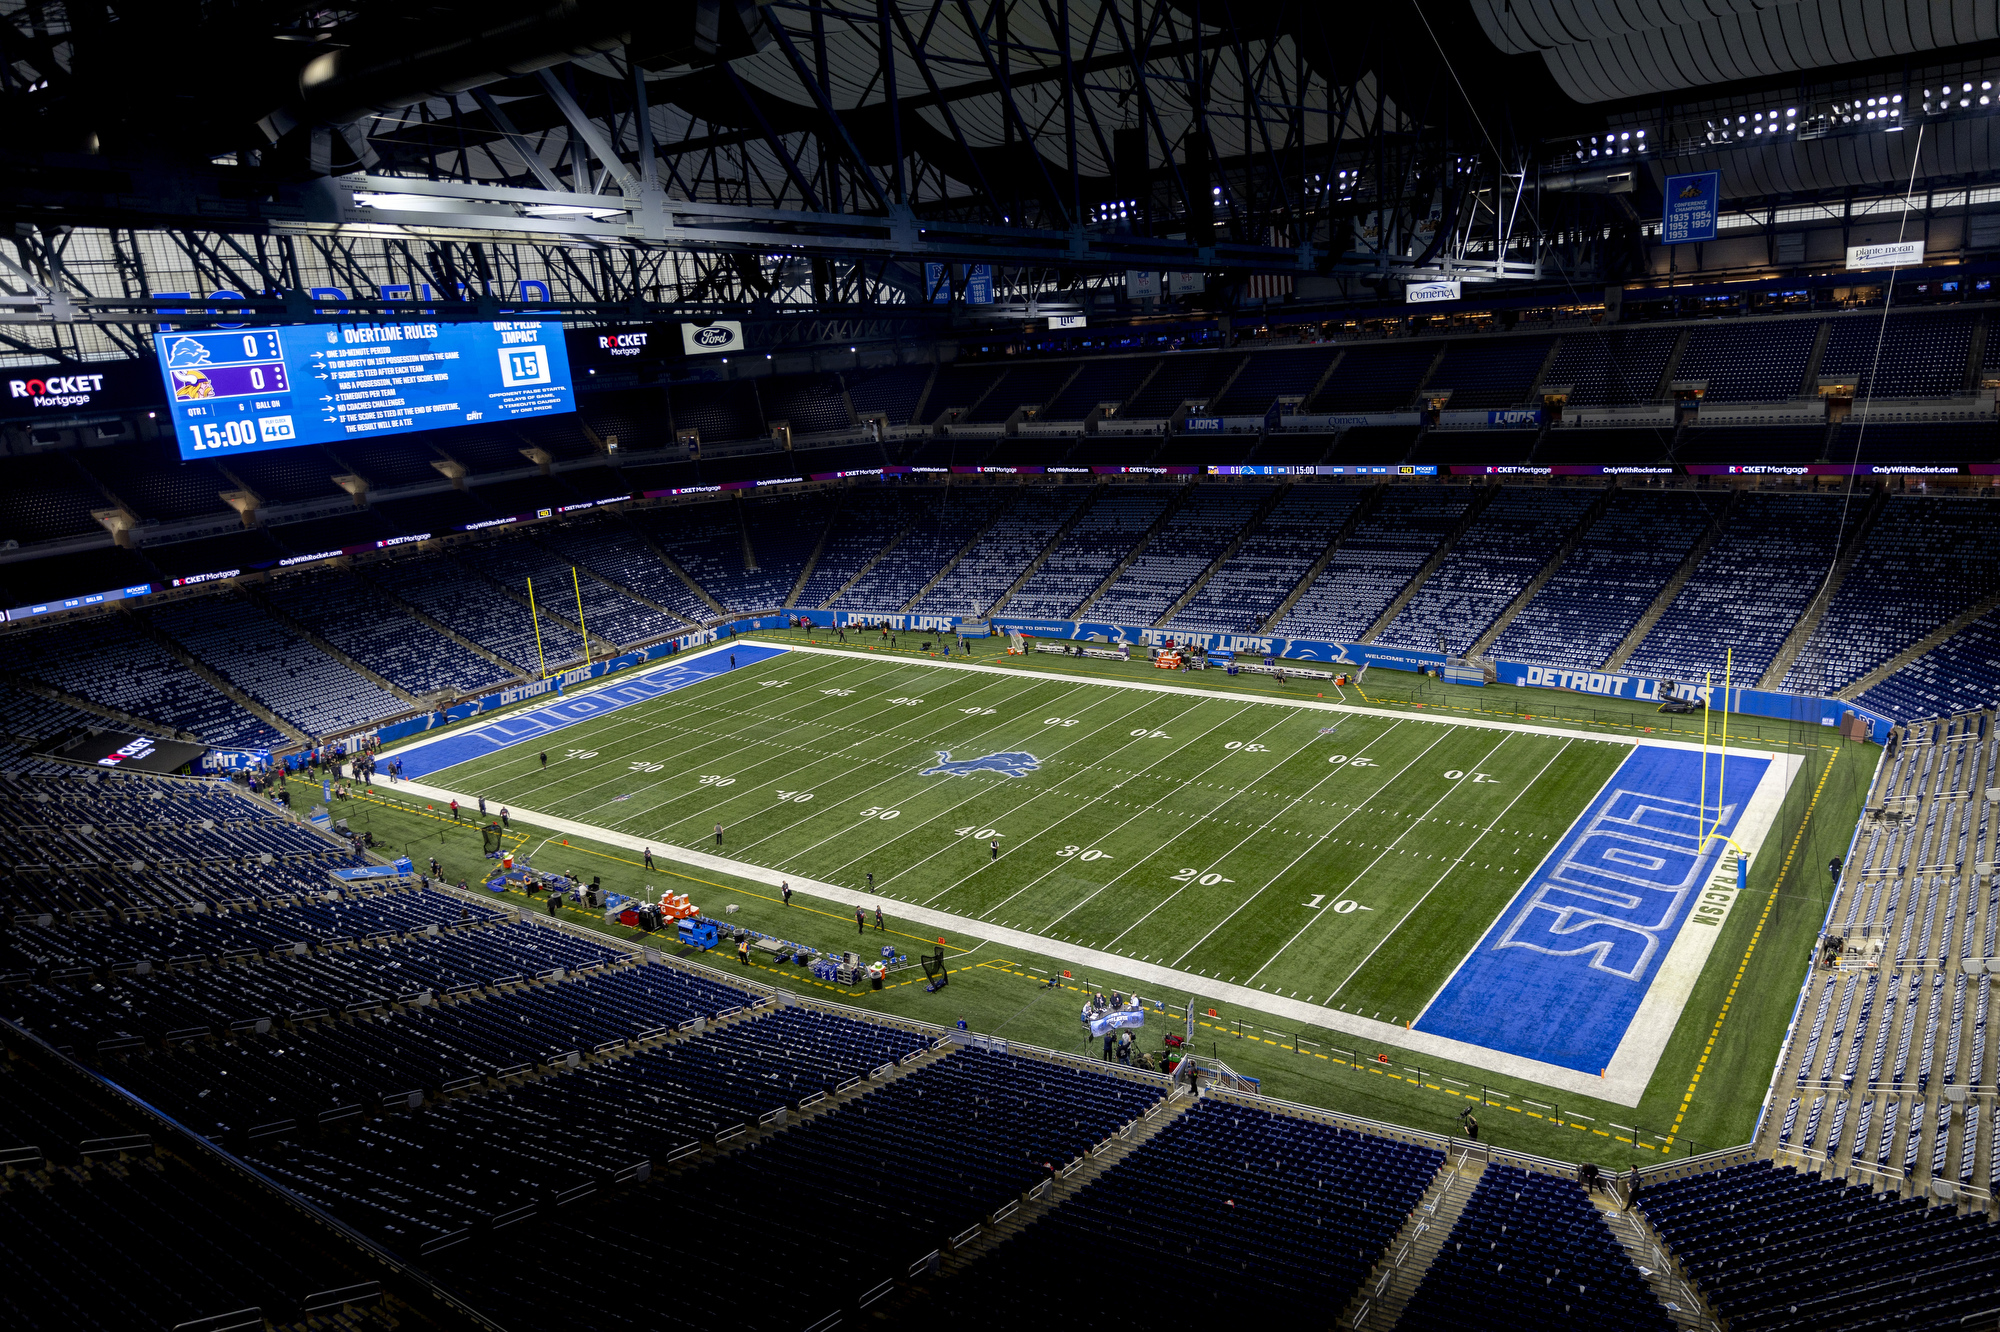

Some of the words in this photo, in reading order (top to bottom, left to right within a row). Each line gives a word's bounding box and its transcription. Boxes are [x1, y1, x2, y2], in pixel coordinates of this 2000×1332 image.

[1674, 200, 1707, 208] CONFERENCE
[1669, 212, 1689, 222] 1935
[1691, 210, 1711, 220] 1954
[1669, 221, 1688, 230] 1952
[1691, 219, 1711, 228] 1957
[1668, 230, 1688, 239] 1953
[1856, 248, 1883, 257] plante
[1885, 245, 1914, 253] moran
[344, 325, 403, 343] OVERTIME
[404, 322, 438, 339] RULES
[493, 322, 513, 331] ONE
[513, 322, 542, 330] PRIDE
[501, 330, 538, 344] IMPACT
[599, 333, 647, 348] ROCKET
[701, 329, 727, 345] Ford
[242, 335, 258, 357] 0
[326, 349, 338, 358] ONE
[338, 347, 370, 357] 10-MINUTE
[370, 345, 391, 355] PERIOD
[611, 347, 640, 356] Mortgage
[328, 360, 337, 369] TD
[336, 360, 346, 368] OR
[345, 358, 366, 368] SAFETY
[366, 357, 375, 366] ON
[375, 357, 386, 365] 1ST
[385, 354, 419, 365] POSSESSION
[419, 353, 434, 362] WINS
[434, 352, 445, 361] THE
[445, 351, 460, 360] GAME
[512, 356, 537, 377] 15
[250, 368, 265, 389] 0
[331, 372, 337, 380] IF
[338, 370, 357, 379] SCORE
[357, 369, 364, 378] IS
[364, 368, 378, 377] TIED
[378, 367, 395, 376] AFTER
[395, 366, 409, 375] EACH
[409, 365, 424, 374] TEAM
[9, 374, 103, 398] ROCKET
[339, 382, 351, 390] HAS
[392, 378, 403, 386] THE
[403, 377, 416, 385] NEXT
[416, 375, 434, 384] SCORE
[434, 374, 449, 383] WINS
[33, 394, 90, 407] Mortgage
[335, 393, 340, 401] 2
[339, 391, 369, 401] TIMEOUTS
[369, 390, 381, 399] PER
[380, 389, 396, 398] TEAM
[255, 401, 270, 409] BALL
[337, 404, 346, 412] NO
[346, 402, 372, 411] COACHES
[372, 399, 405, 409] CHALLENGES
[504, 401, 536, 409] TIMEOUTS
[188, 408, 201, 417] QTR
[202, 407, 206, 415] 1
[346, 414, 358, 422] THE
[357, 412, 376, 421] SCORE
[376, 411, 383, 419] IS
[383, 410, 397, 418] TIED
[396, 409, 404, 417] AT
[404, 408, 415, 416] THE
[414, 407, 425, 415] END
[425, 406, 433, 414] OF
[466, 412, 483, 421] GRIT
[1494, 411, 1536, 423] LIONS
[265, 424, 290, 437] 40
[345, 423, 357, 432] THE
[357, 420, 377, 431] RESULT
[377, 419, 391, 429] WILL
[391, 418, 399, 427] BE
[403, 417, 413, 426] TIE
[1188, 419, 1219, 429] LIONS
[189, 420, 257, 450] 15:00
[860, 468, 883, 476] Mortgage
[996, 466, 1017, 474] Mortgage
[1143, 466, 1167, 474] Mortgage
[1295, 466, 1314, 475] 15:00
[1401, 466, 1412, 474] 40
[1486, 466, 1517, 474] ROCKET
[1517, 466, 1552, 475] Mortgage
[1603, 466, 1672, 474] OnlyWithRocket.com
[1729, 466, 1766, 474] ROCKET
[1767, 466, 1808, 475] Mortgage
[1872, 466, 1958, 475] OnlyWithRocket.com
[672, 487, 695, 495] ROCKET
[696, 485, 721, 493] Mortgage
[465, 516, 517, 530] OnlyWithRocket.com
[377, 537, 403, 548] ROCKET
[403, 533, 431, 543] Mortgage
[279, 549, 343, 566] OnlyWithRocket.com
[172, 574, 206, 587] ROCKET
[206, 569, 240, 581] Mortgage
[127, 585, 148, 594] ROCKET
[848, 613, 905, 629] DETROIT
[910, 615, 952, 631] LIONS
[680, 628, 717, 650] LIONS
[1141, 629, 1213, 650] DETROIT
[1220, 635, 1273, 653] LIONS
[1365, 653, 1404, 662] WELCOME
[769, 679, 792, 688] 10
[1526, 666, 1629, 696] DETROIT
[500, 678, 553, 705] DETROIT
[829, 688, 857, 697] 20
[460, 666, 717, 747] LIONS
[896, 697, 924, 706] 30
[968, 707, 997, 717] 40
[1043, 717, 1079, 729] 50
[1130, 729, 1165, 740] 40
[98, 737, 155, 766] ROCKET
[1224, 741, 1260, 753] 30
[571, 748, 599, 760] 10
[202, 753, 239, 769] GRIT
[635, 760, 665, 773] 20
[1328, 754, 1366, 768] 20
[703, 774, 737, 788] 30
[1443, 769, 1488, 784] 10
[779, 790, 815, 803] 40
[859, 806, 901, 821] 50
[953, 826, 998, 842] 40
[1055, 844, 1104, 863] 30
[1170, 867, 1224, 887] 20
[1491, 788, 1738, 982] LIONS
[1301, 893, 1360, 915] 10
[1692, 875, 1737, 927] RACISM
[1208, 1008, 1215, 1016] 10
